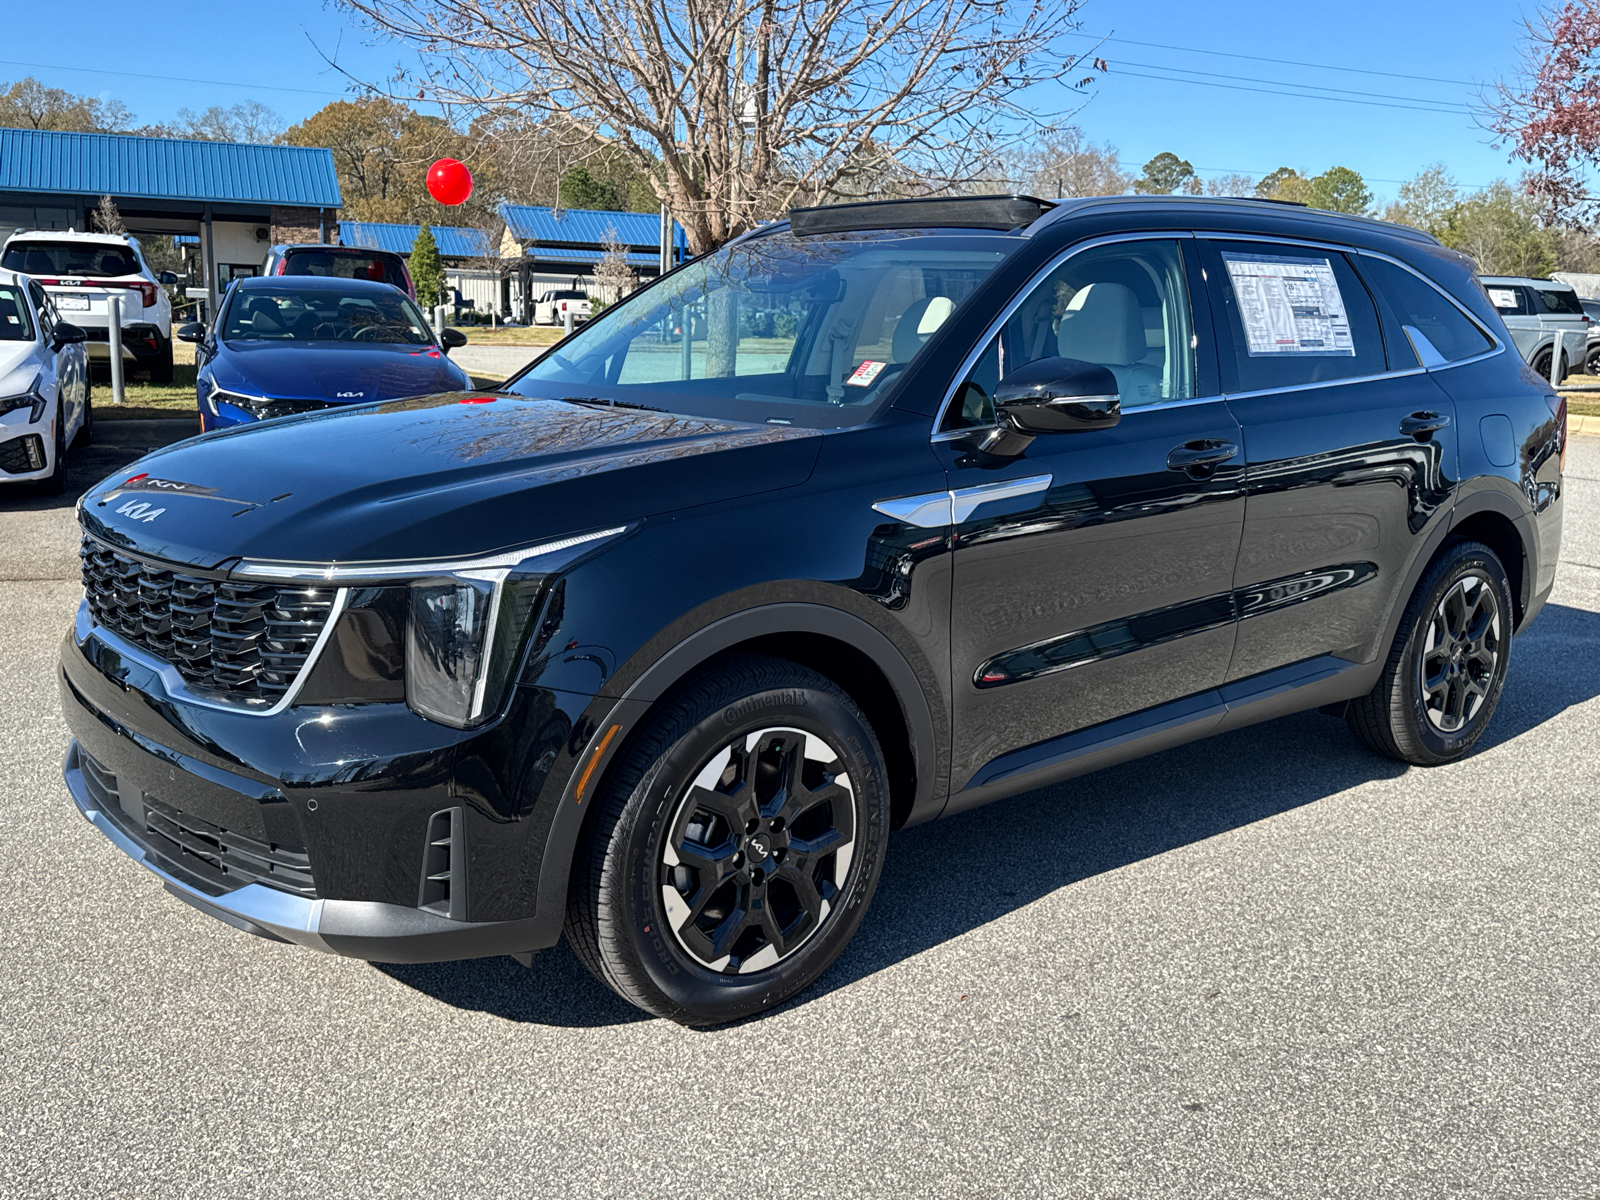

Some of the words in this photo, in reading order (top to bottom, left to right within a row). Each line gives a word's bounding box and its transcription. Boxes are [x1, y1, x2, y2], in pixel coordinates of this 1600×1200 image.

[115, 498, 167, 523] KIA
[722, 690, 799, 726] Continental
[848, 735, 879, 910] CONTINENTAL
[751, 838, 768, 858] KIA
